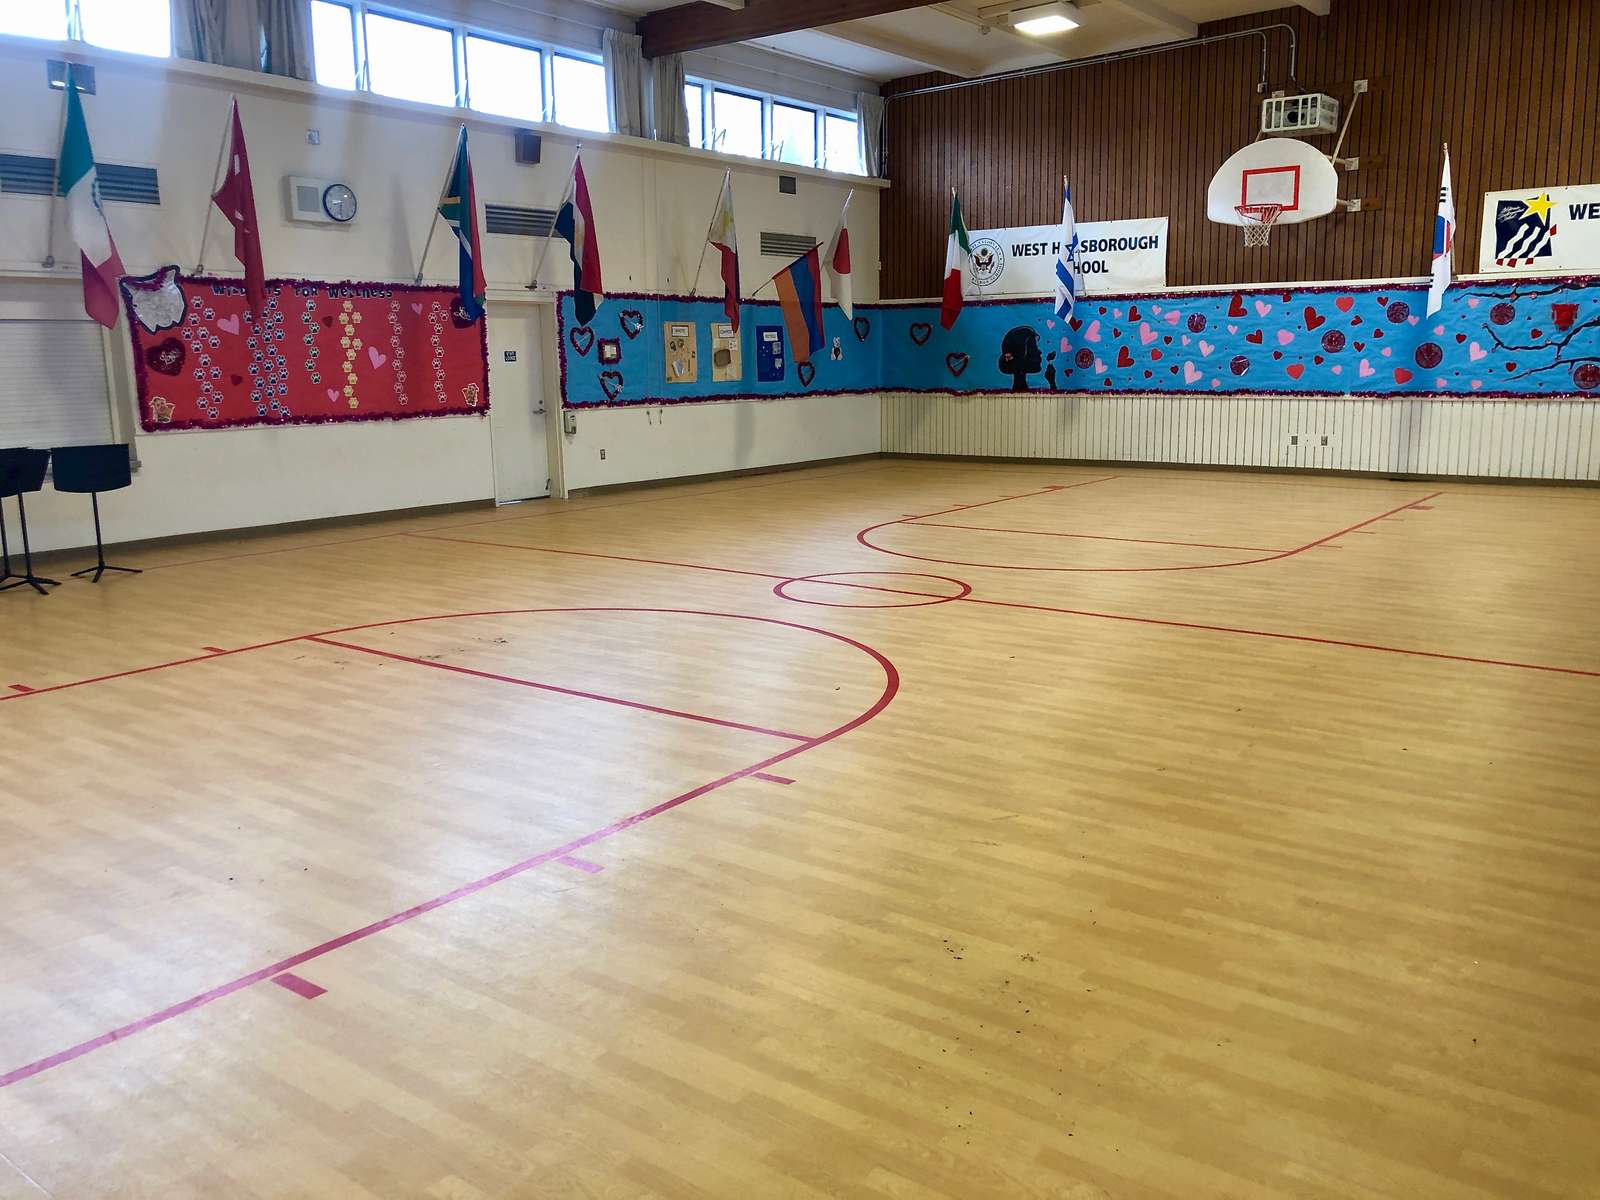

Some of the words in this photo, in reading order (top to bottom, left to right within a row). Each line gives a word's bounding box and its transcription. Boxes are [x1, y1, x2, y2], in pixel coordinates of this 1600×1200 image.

[1012, 243, 1048, 257] WEST
[1052, 235, 1159, 255] HSBOROUGH
[1073, 260, 1109, 275] HOOL
